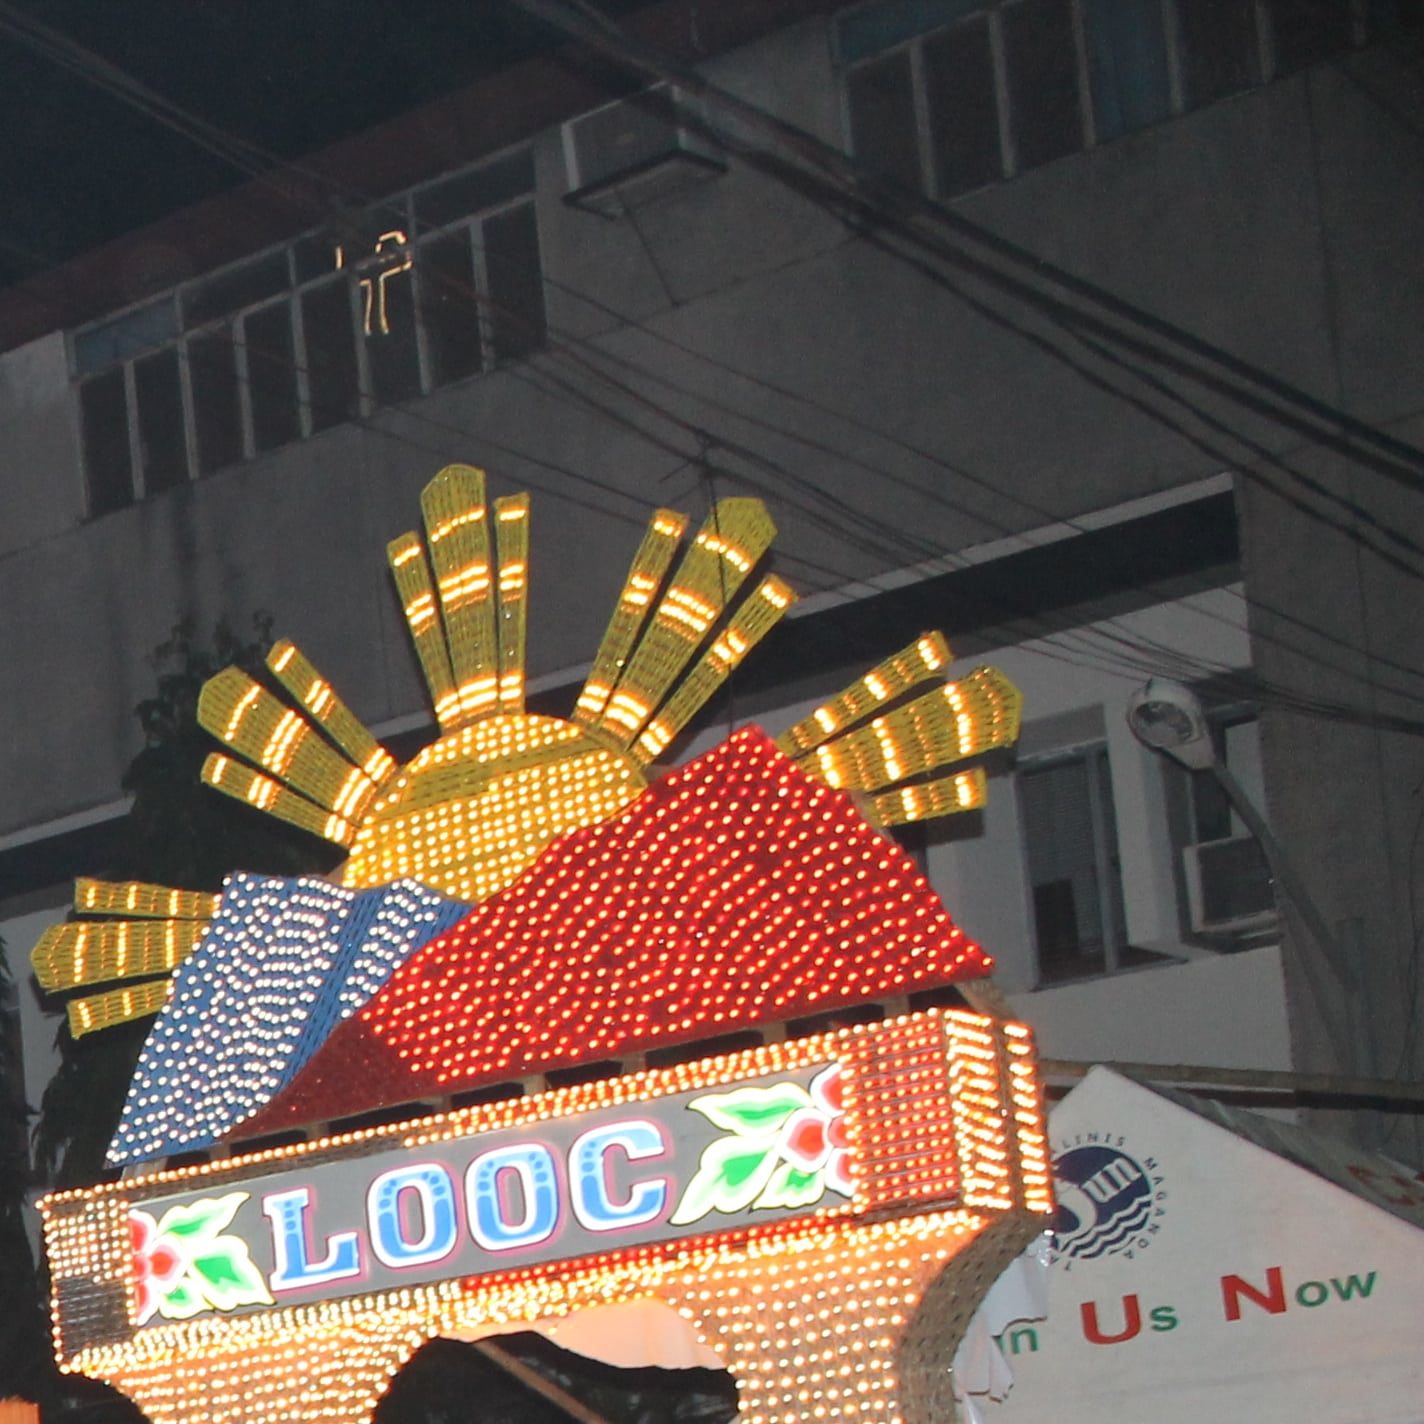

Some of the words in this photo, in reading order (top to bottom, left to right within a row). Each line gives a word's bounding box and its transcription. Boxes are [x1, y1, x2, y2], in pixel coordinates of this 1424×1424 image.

[260, 1117, 671, 1295] LOOC
[1080, 1294, 1179, 1345] Us
[1220, 1266, 1378, 1322] Now
